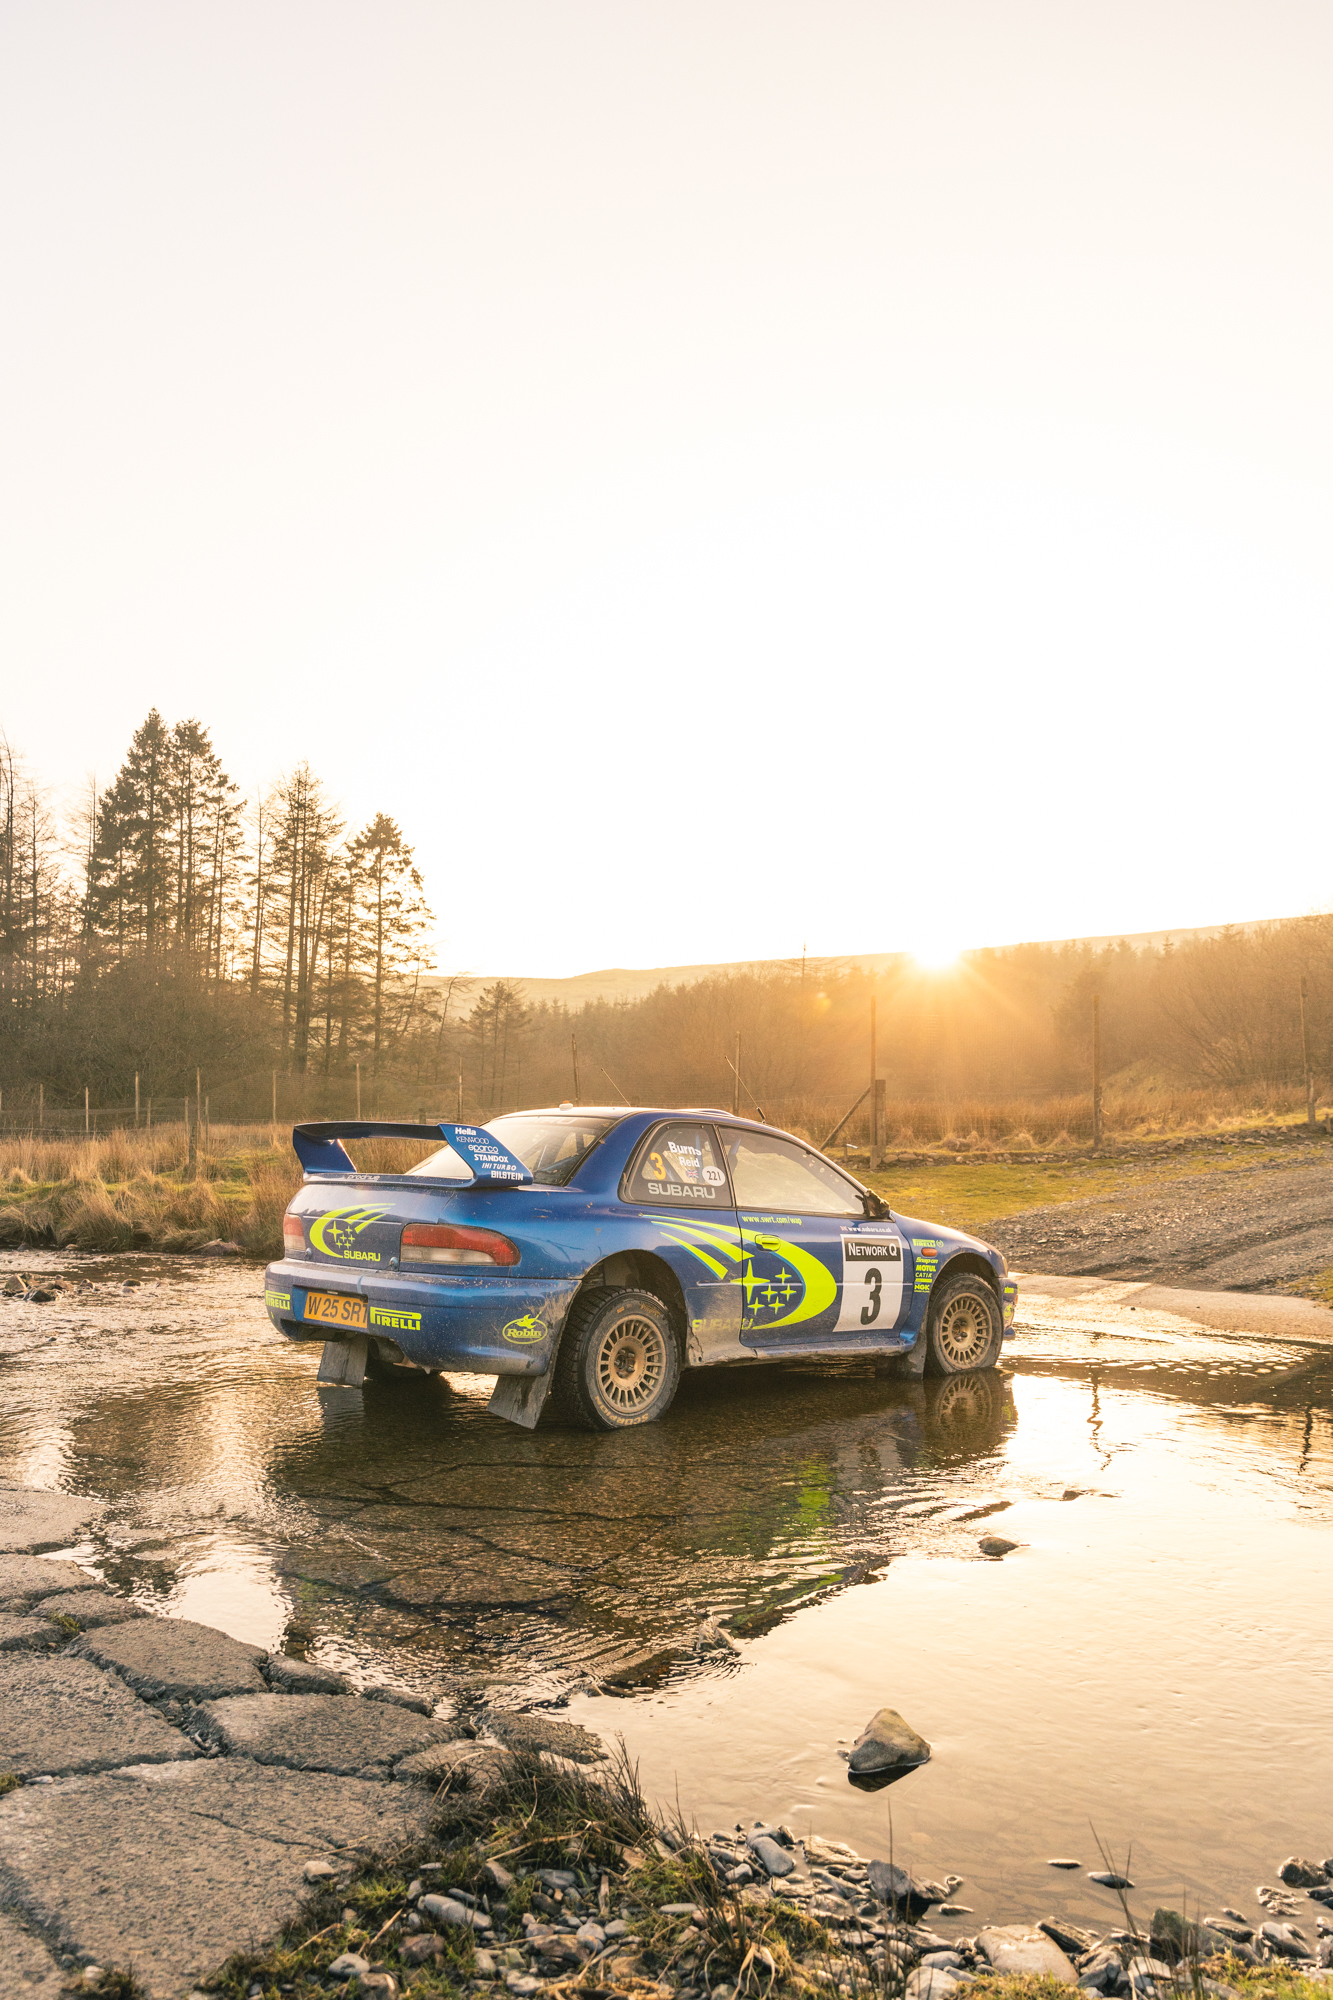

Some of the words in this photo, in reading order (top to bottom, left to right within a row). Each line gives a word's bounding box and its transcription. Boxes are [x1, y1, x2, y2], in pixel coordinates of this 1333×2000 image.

[455, 1127, 477, 1136] Hella
[456, 1136, 490, 1145] KENWOOD
[468, 1144, 499, 1154] sparco
[667, 1141, 702, 1156] Burns
[474, 1154, 509, 1163] STANDOX
[678, 1156, 701, 1168] Reid
[493, 1163, 517, 1171] TURBO
[650, 1152, 667, 1180] 3
[491, 1170, 524, 1181] BILSTEIN
[706, 1170, 722, 1181] 221
[647, 1182, 716, 1199] SUBARU
[742, 1215, 803, 1226] www.swrt.com/wap
[848, 1243, 888, 1256] NETWORK
[889, 1243, 897, 1256] Q
[343, 1250, 381, 1262] SUBARU
[265, 1290, 291, 1310] PIRELLI
[860, 1267, 882, 1325] 3
[308, 1296, 322, 1316] W
[321, 1298, 338, 1319] 25
[370, 1306, 422, 1331] PIRELLI
[507, 1328, 542, 1338] Robin
[594, 1395, 649, 1425] SCORPION
